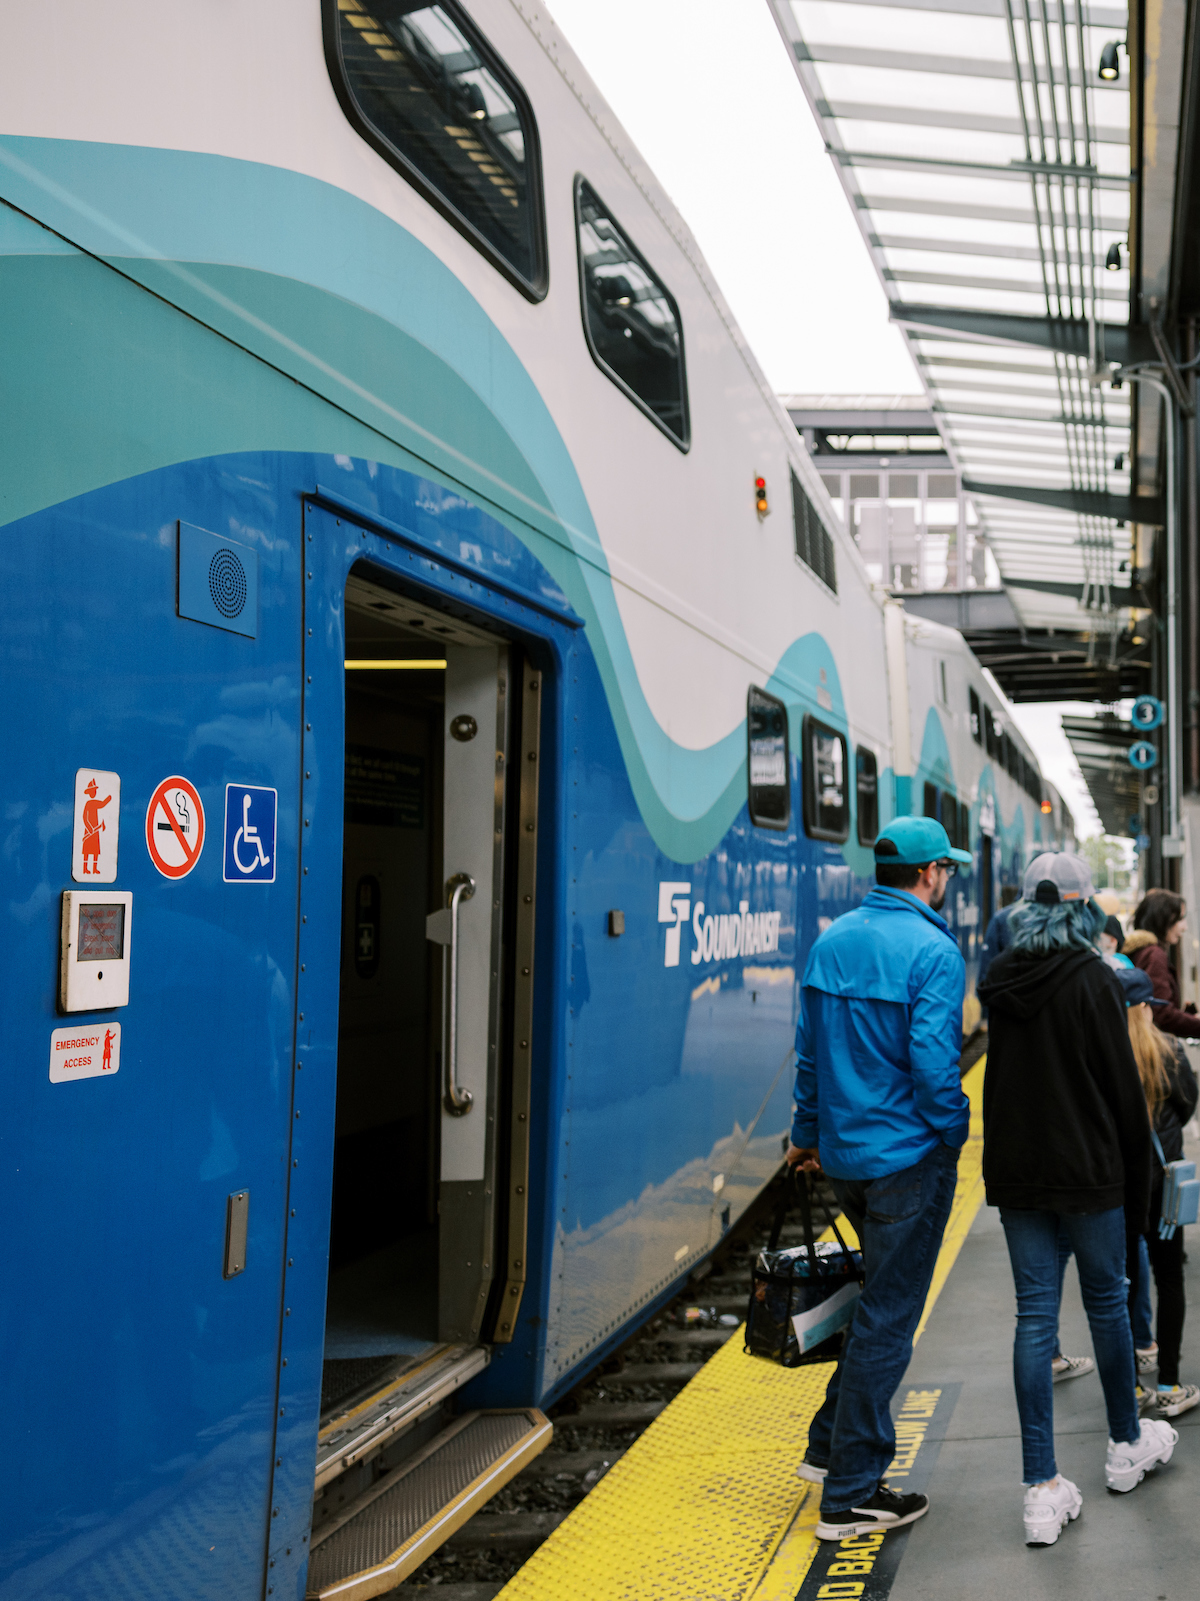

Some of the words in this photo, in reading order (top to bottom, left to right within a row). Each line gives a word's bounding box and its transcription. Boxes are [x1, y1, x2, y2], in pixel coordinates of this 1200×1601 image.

[1140, 702, 1155, 724] 3
[56, 1036, 99, 1050] EMERGENCY
[63, 1056, 92, 1068] ACCESS
[826, 1529, 888, 1577] BAC
[897, 1388, 943, 1419] LINE
